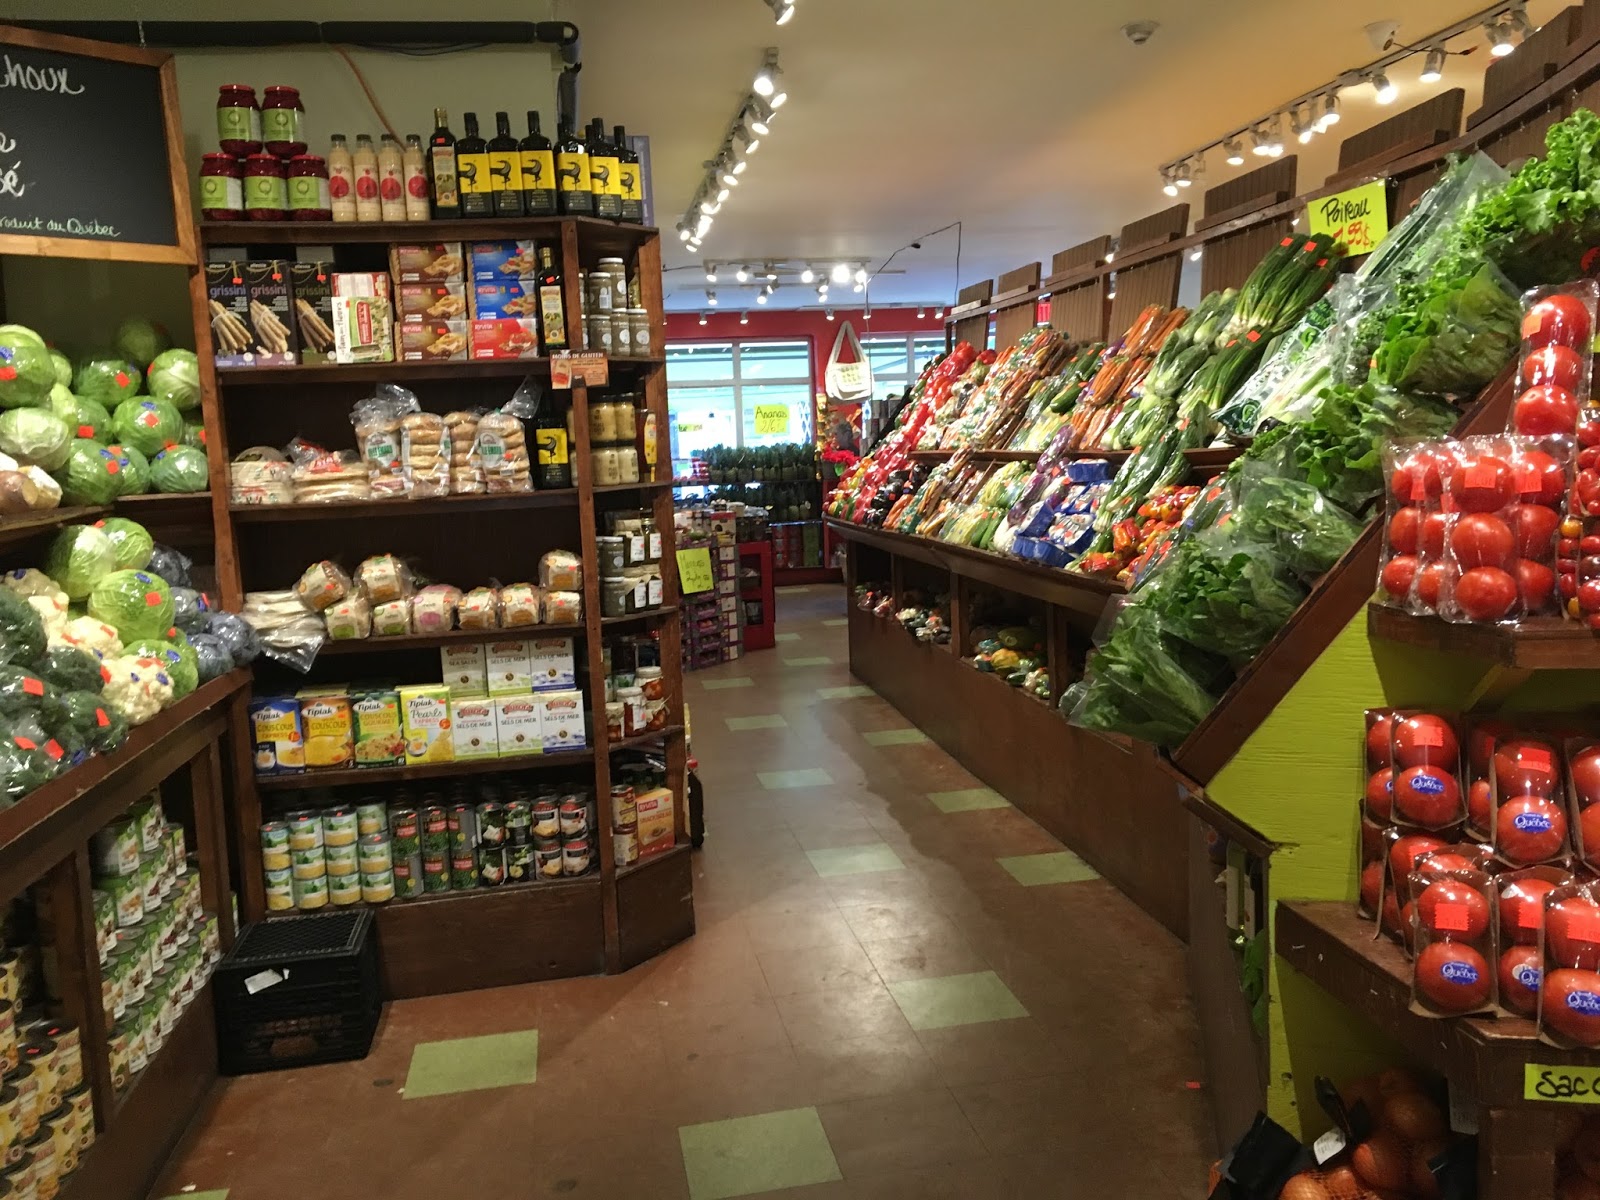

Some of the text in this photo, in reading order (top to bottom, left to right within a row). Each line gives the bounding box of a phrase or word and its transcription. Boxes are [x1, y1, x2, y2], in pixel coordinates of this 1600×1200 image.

[1320, 197, 1371, 227] Poireau
[0, 215, 43, 229] roduit
[209, 284, 247, 299] grissini
[250, 284, 287, 298] grissini
[295, 284, 331, 298] grissini
[474, 322, 494, 330] RYVITA
[755, 406, 788, 419] Ananas
[257, 722, 295, 733] COUSCOUS
[311, 720, 347, 731] COUSCOUS
[1411, 776, 1444, 793] Québec
[1515, 815, 1551, 829] Québec
[1442, 963, 1479, 980] Québec
[1535, 1070, 1589, 1099] Sac
